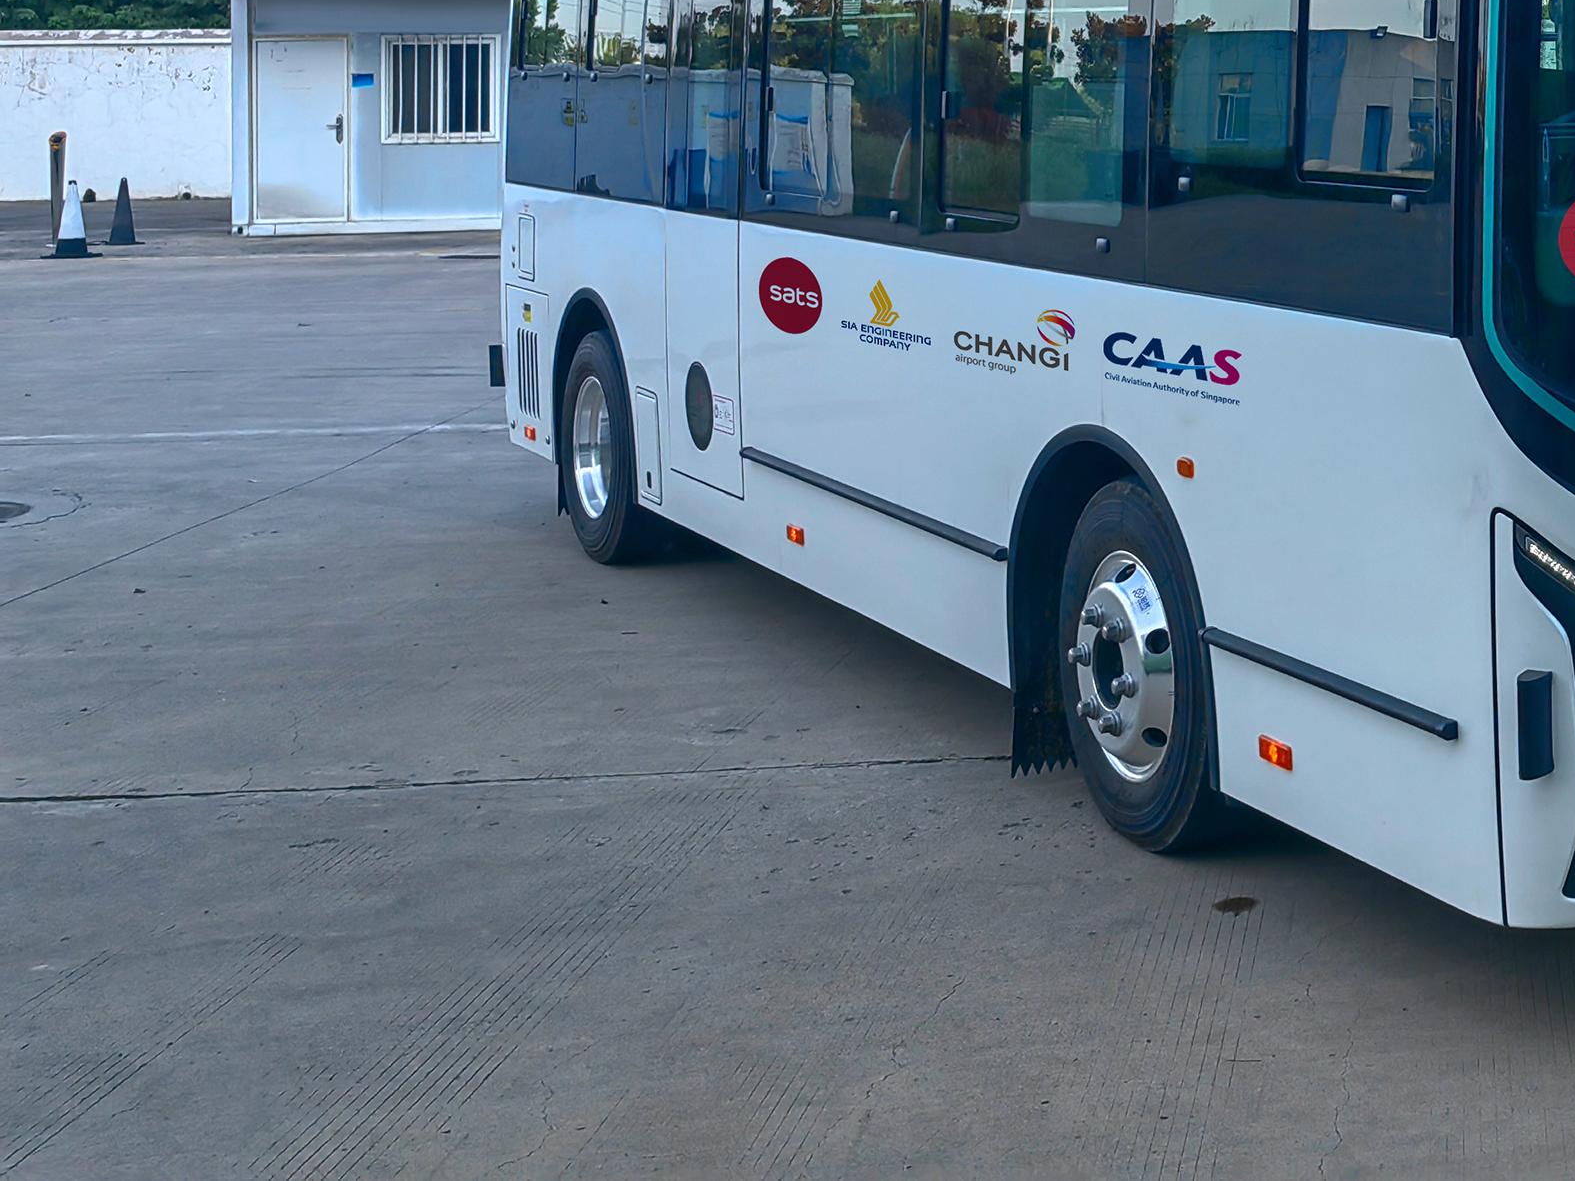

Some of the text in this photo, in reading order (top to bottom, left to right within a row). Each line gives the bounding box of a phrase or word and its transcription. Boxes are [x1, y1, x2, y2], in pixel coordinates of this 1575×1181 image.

[769, 285, 819, 308] sats
[841, 320, 932, 346] SIA ENGINEERING
[859, 334, 911, 351] COMPANY
[953, 330, 1069, 371] CHANGI
[1103, 332, 1242, 386] CAAS
[955, 354, 1017, 374] airport group
[1104, 372, 1240, 406] Civil Aviation Authority of Singapore
